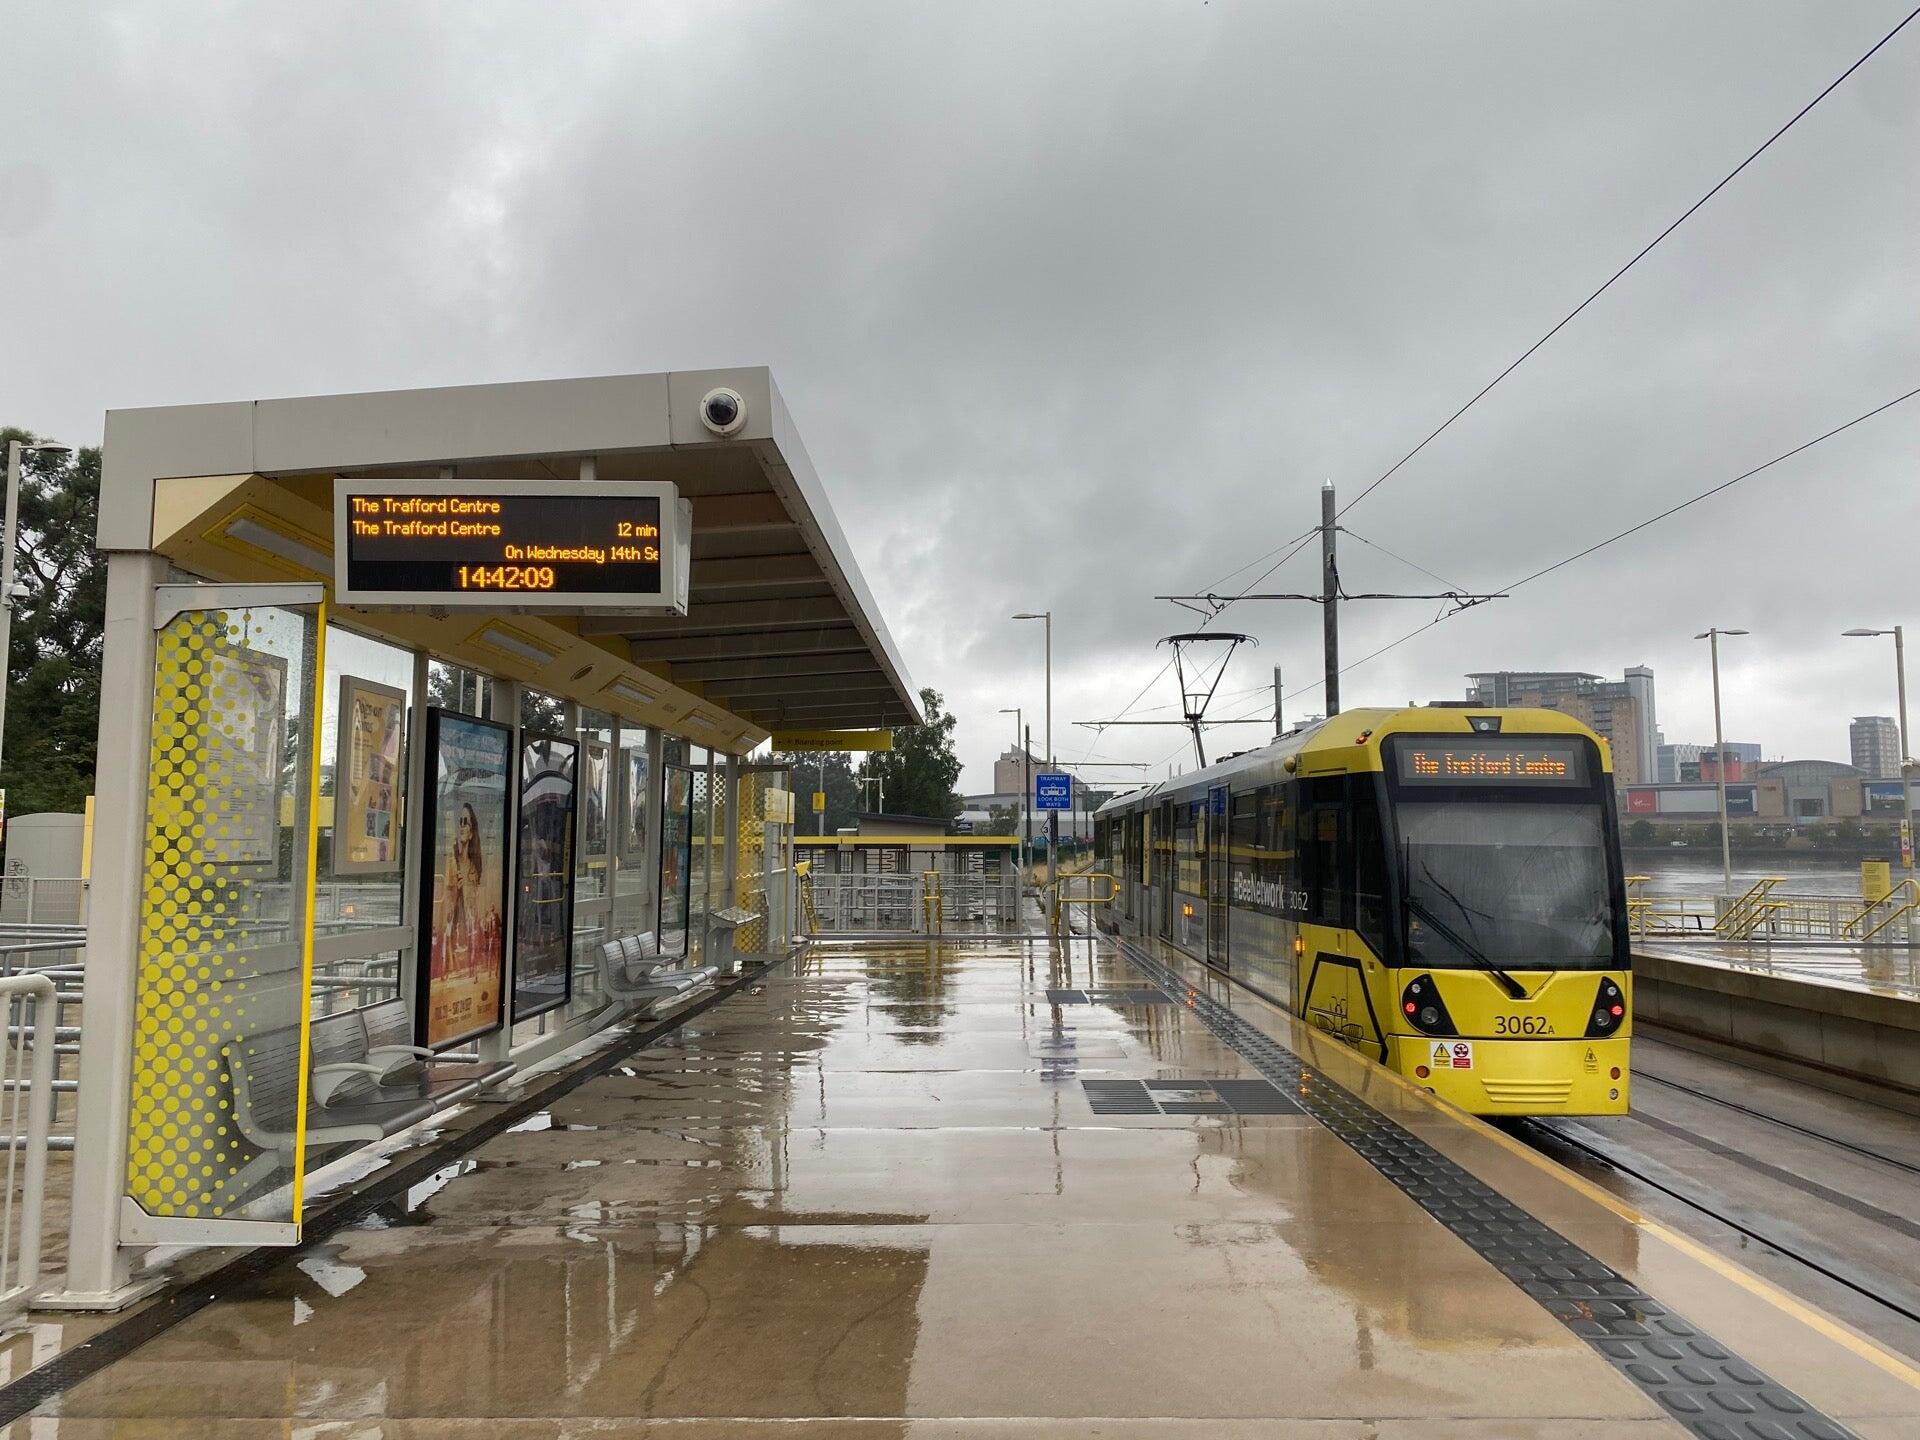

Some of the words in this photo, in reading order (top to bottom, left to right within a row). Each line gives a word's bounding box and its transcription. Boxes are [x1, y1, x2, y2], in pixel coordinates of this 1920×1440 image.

[352, 497, 379, 514] The
[383, 498, 446, 514] Trafford
[450, 498, 501, 514] Centre
[352, 520, 379, 536] The
[383, 521, 446, 537] Trafford
[450, 521, 501, 537] Centre
[617, 522, 632, 537] 12
[635, 524, 657, 537] min
[505, 545, 524, 560] On
[527, 545, 605, 564] Wednesday
[610, 545, 641, 560] 14th
[458, 566, 554, 589] 14:42:09
[794, 738, 824, 747] Boarding
[826, 738, 843, 747] point
[1413, 753, 1440, 774] The
[1444, 753, 1511, 775] Trafford
[1515, 754, 1565, 775] Centre
[1289, 889, 1309, 911] 3062
